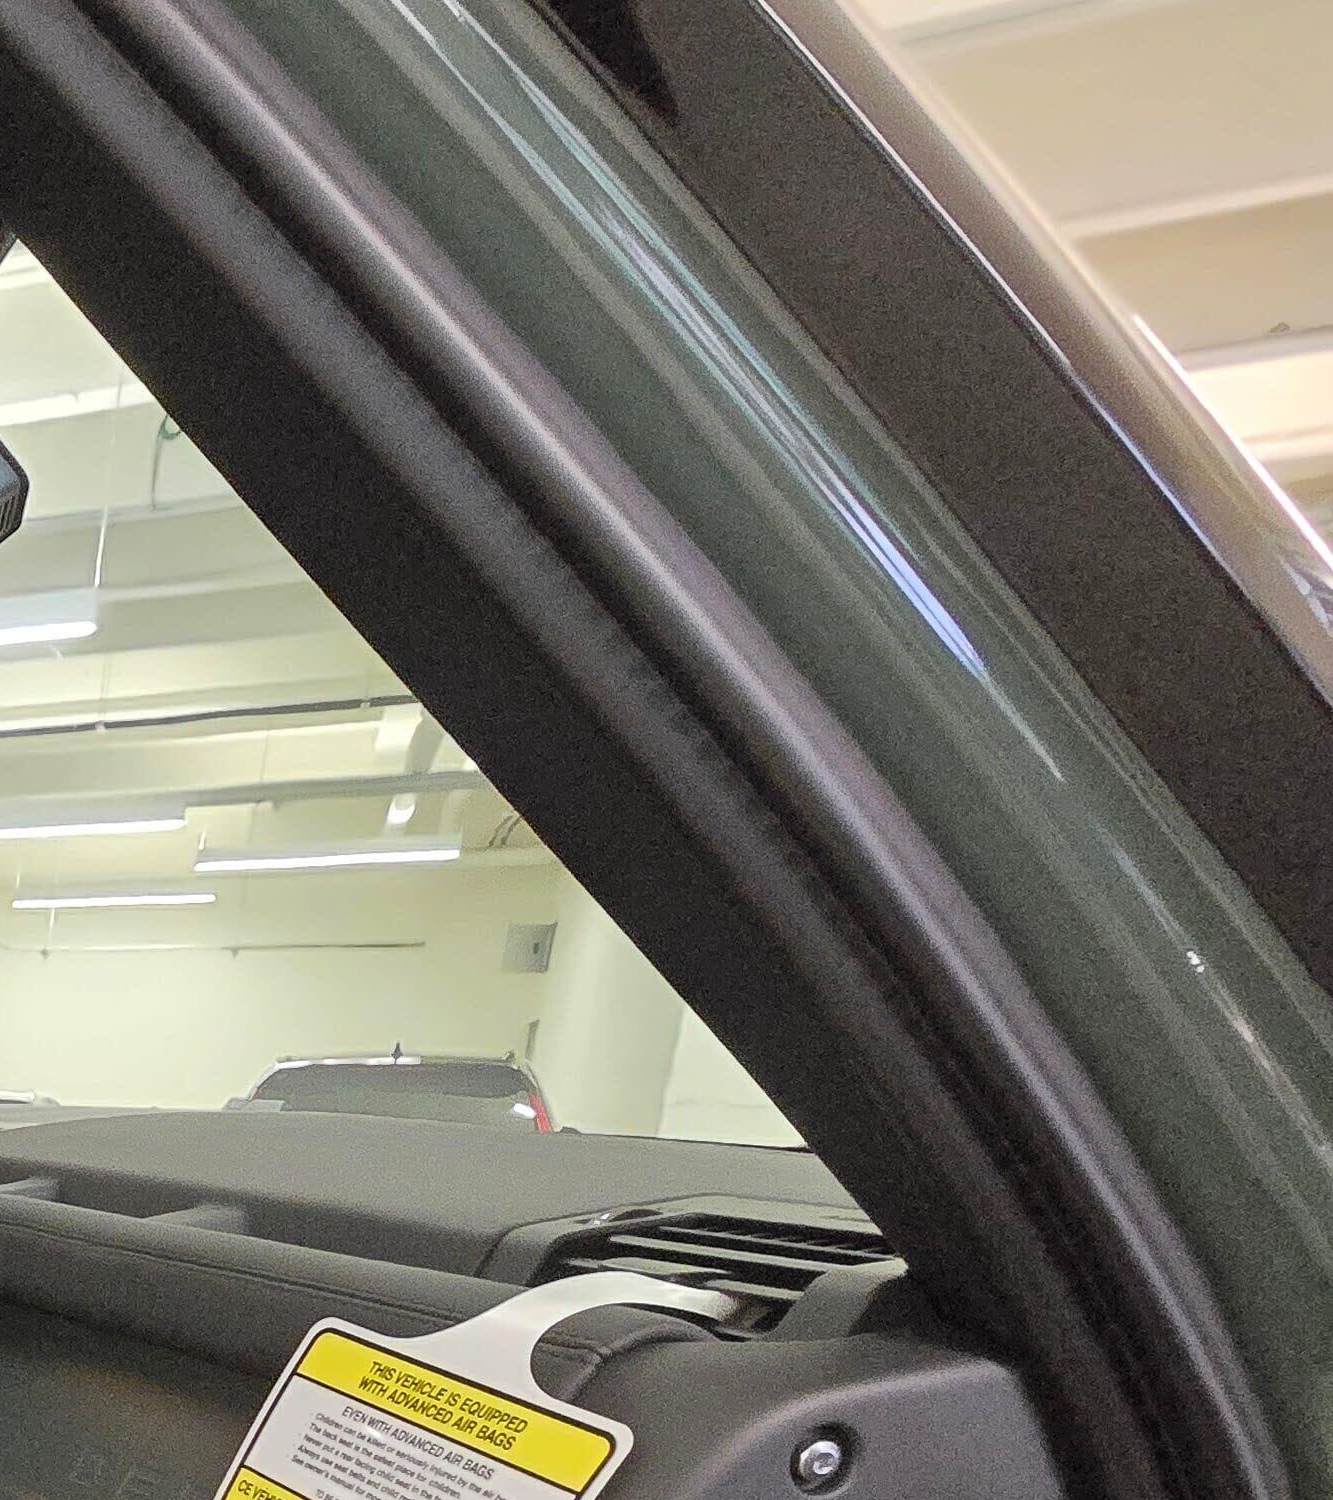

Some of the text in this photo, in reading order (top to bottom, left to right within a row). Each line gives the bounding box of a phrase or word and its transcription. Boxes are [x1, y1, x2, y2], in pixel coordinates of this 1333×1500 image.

[369, 1360, 528, 1433] THIS VEHICLE IS EQUIPPED
[358, 1375, 516, 1450] WITH ADVANCED AIR BAGS
[309, 1422, 321, 1433] The
[341, 1405, 494, 1479] EVEN WITH ADVANCED AIR BAGS
[237, 1479, 253, 1496] CE
[456, 1476, 468, 1487] by
[420, 1489, 432, 1500] the
